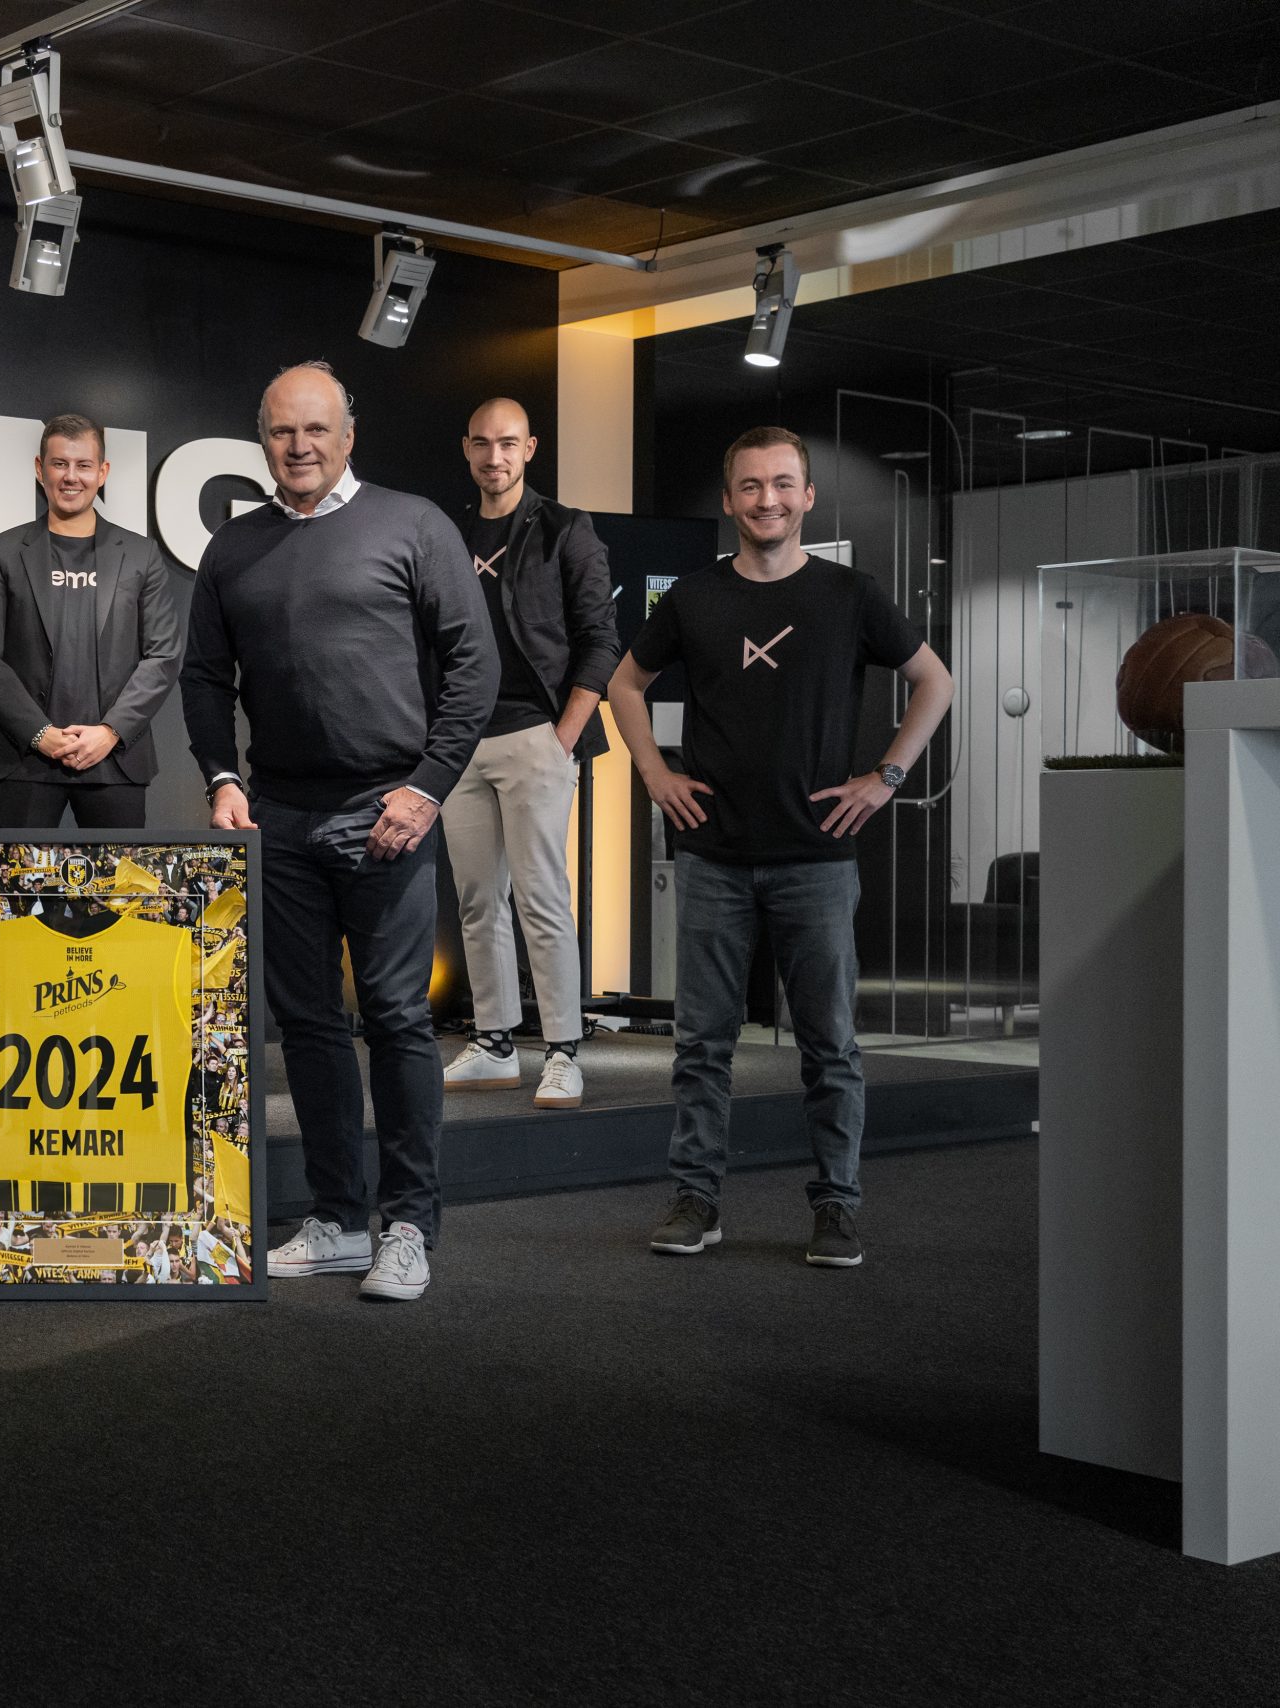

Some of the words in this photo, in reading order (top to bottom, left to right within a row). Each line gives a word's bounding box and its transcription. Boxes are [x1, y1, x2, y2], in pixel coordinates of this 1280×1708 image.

[33, 966, 104, 1013] PRINS
[53, 999, 94, 1019] petfoods
[29, 1129, 124, 1157] KEMARI
